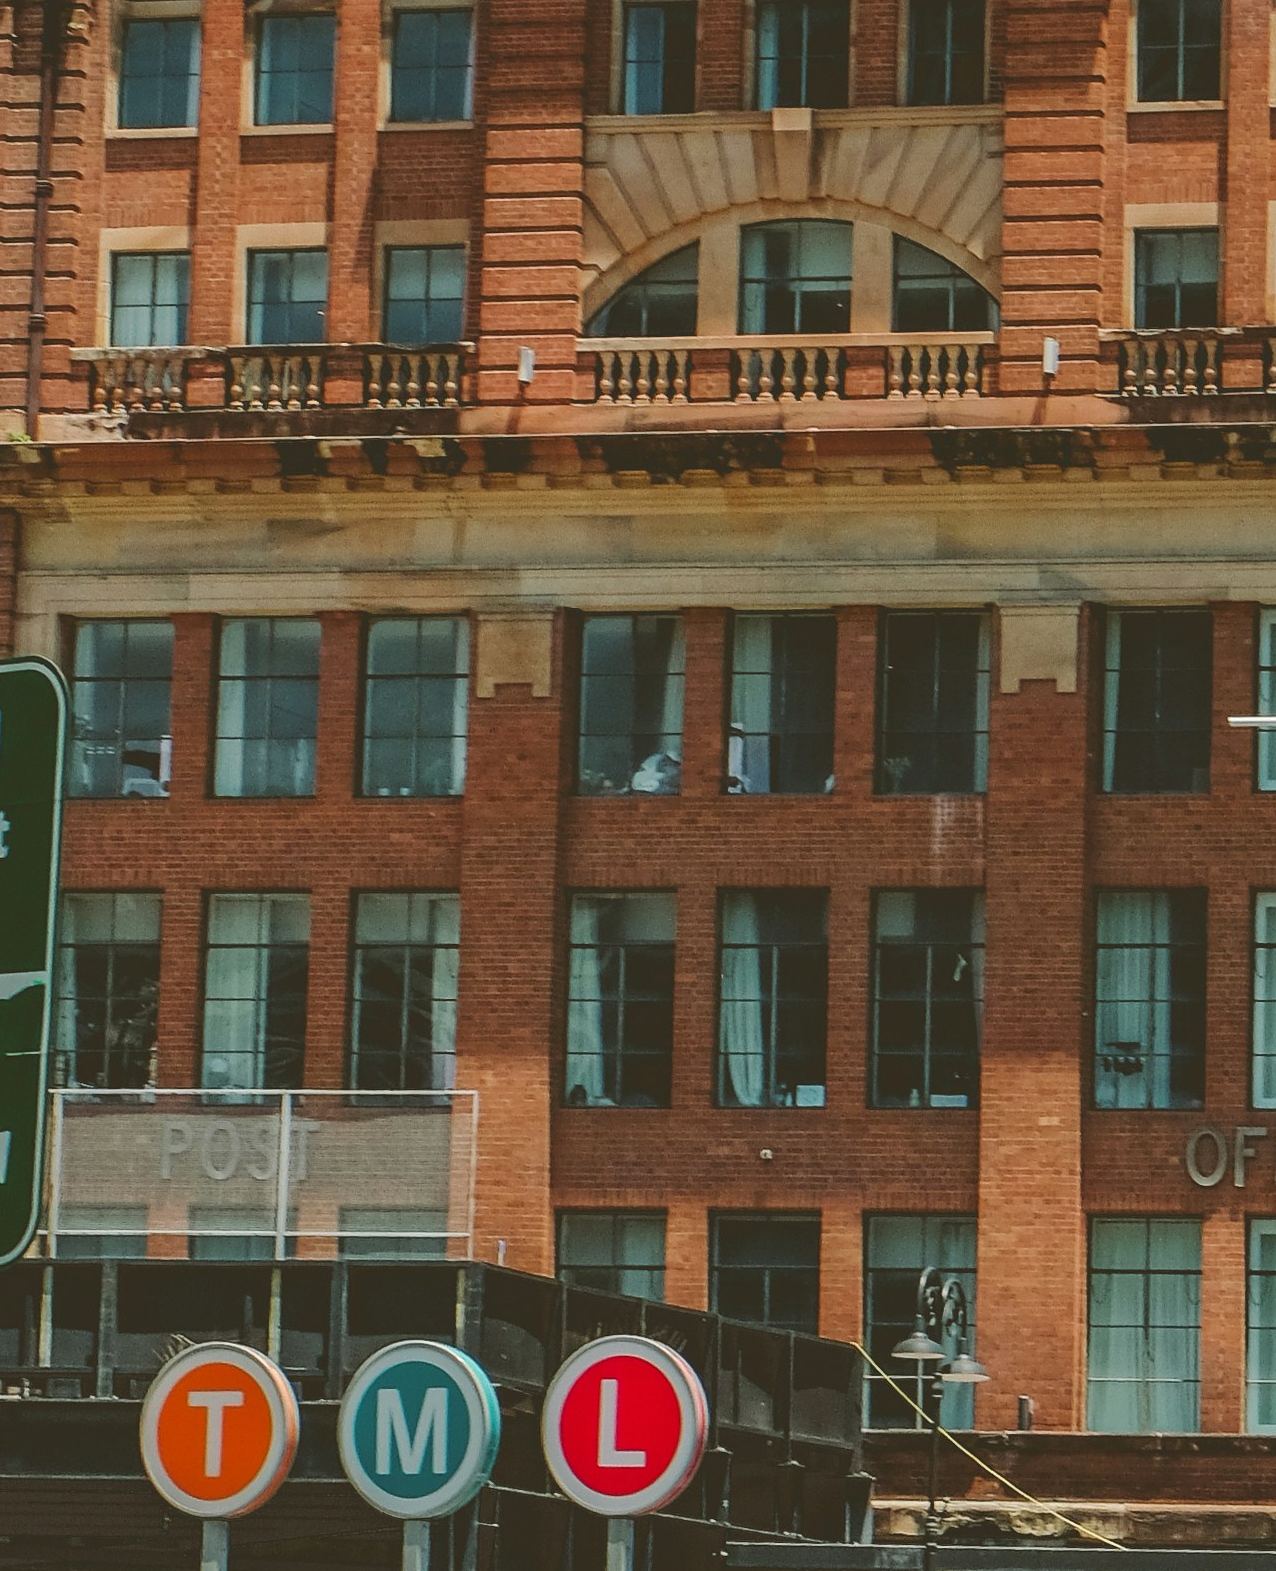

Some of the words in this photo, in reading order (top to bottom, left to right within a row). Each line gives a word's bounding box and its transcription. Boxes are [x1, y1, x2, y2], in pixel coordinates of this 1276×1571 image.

[160, 1119, 321, 1180] POST
[187, 1390, 244, 1478] T
[375, 1387, 449, 1475] M
[597, 1378, 647, 1468] L
